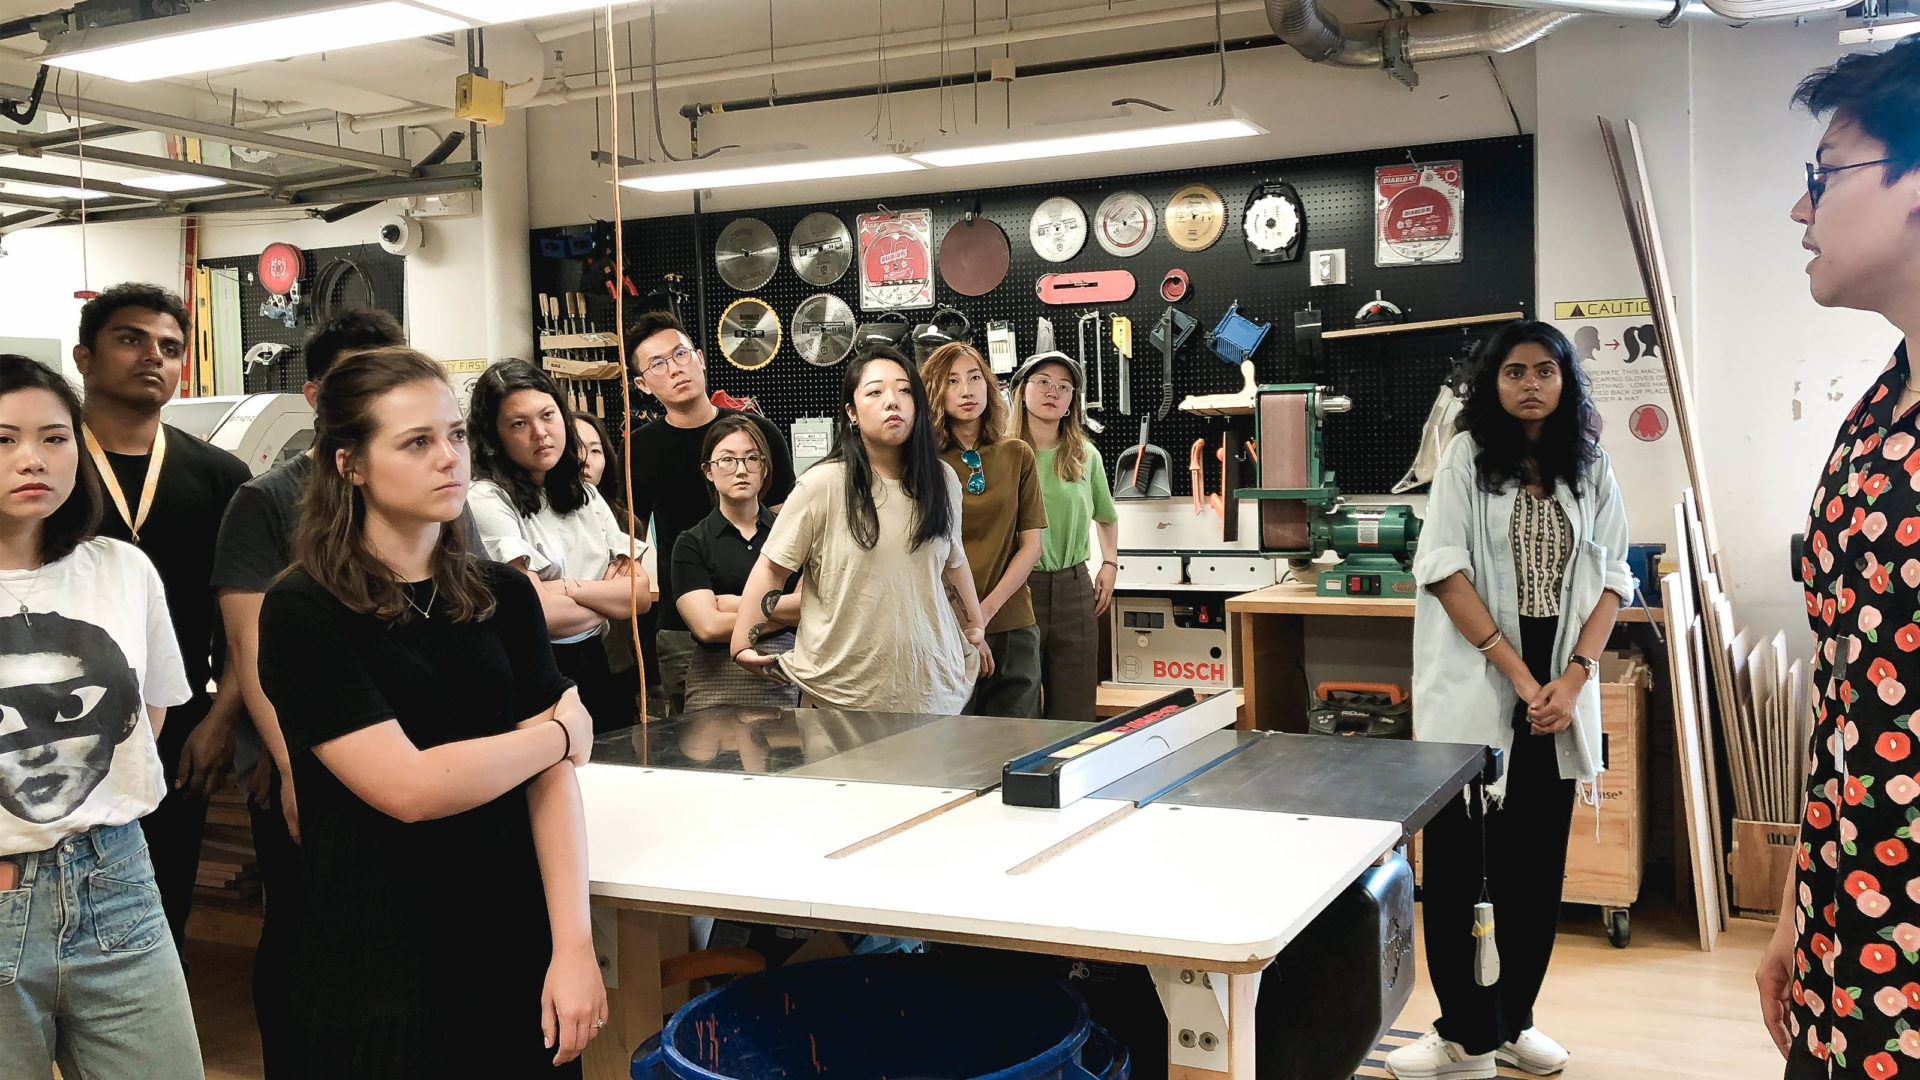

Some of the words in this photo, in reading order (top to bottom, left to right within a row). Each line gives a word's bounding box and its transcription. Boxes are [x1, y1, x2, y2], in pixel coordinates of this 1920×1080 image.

[1588, 302, 1652, 315] CAUTIO
[460, 361, 486, 370] FIRST
[1153, 660, 1225, 681] BOSCH
